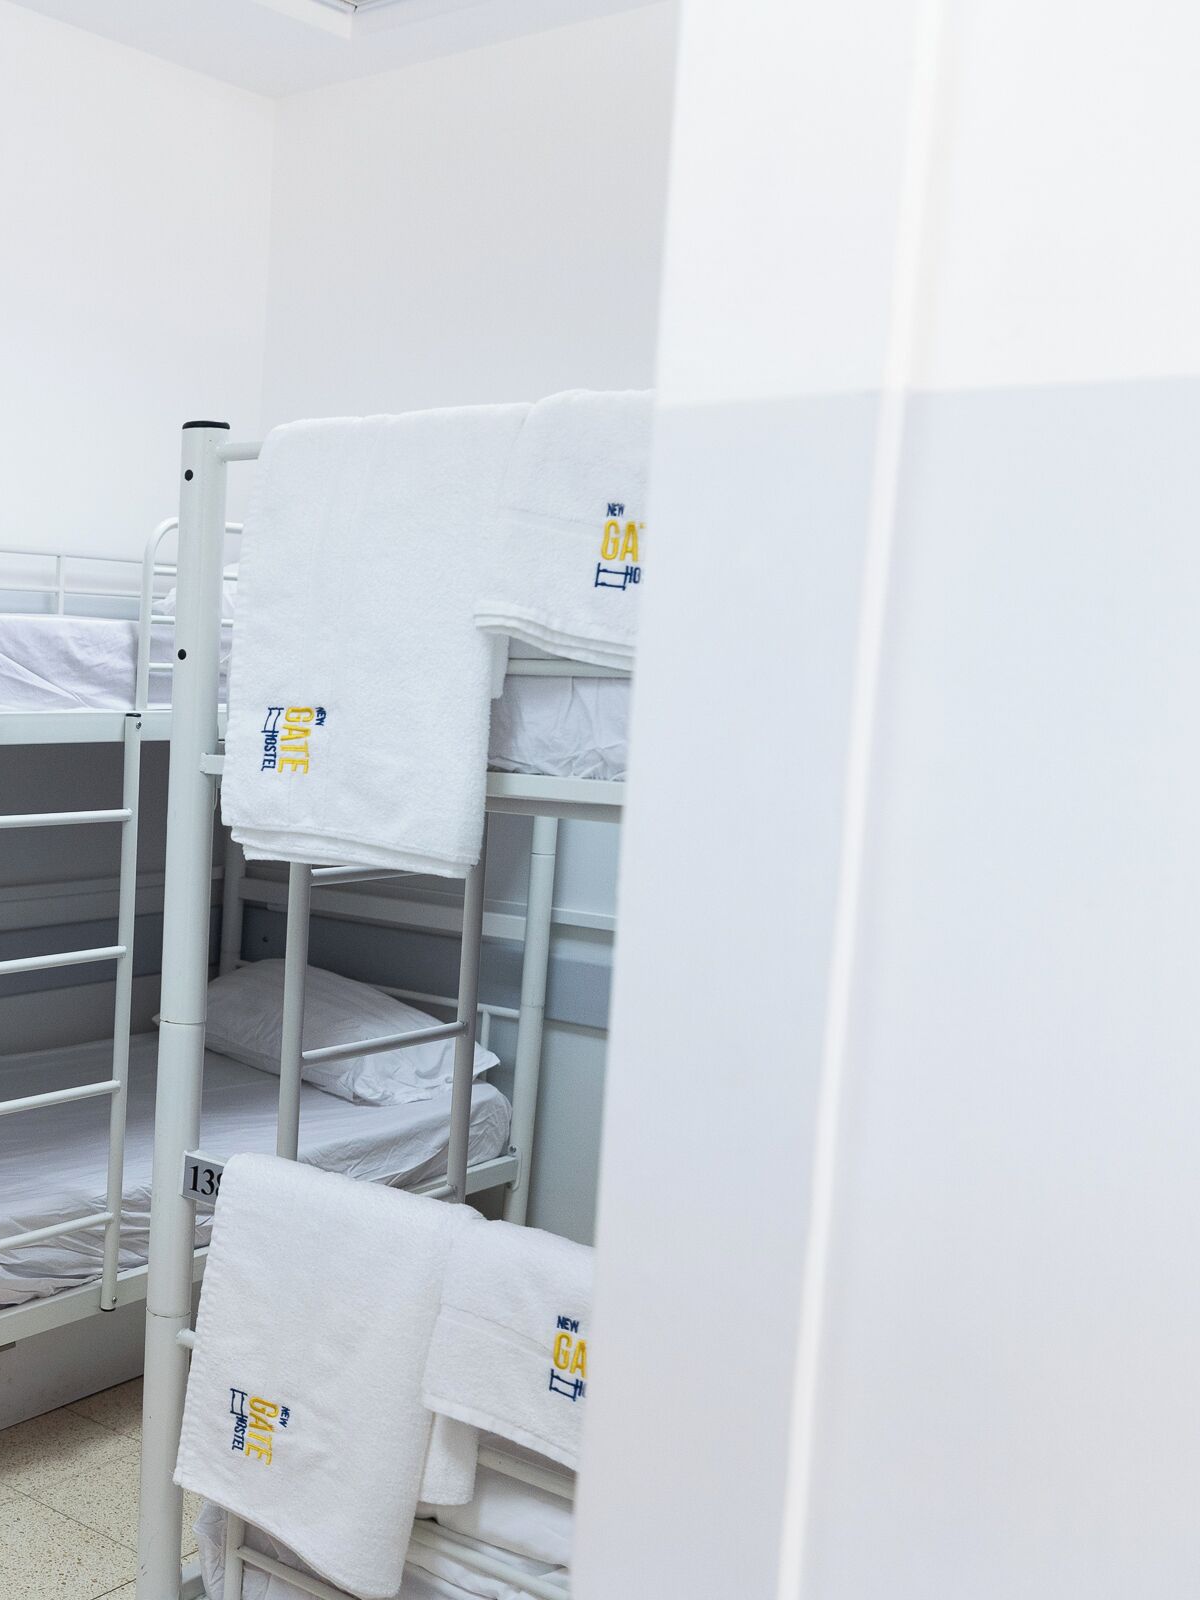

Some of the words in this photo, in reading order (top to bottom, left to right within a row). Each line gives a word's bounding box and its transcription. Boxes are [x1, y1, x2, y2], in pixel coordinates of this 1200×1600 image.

[606, 502, 625, 517] NEW
[601, 519, 646, 563] GA
[315, 706, 327, 727] NEW
[261, 730, 279, 771] HOSTEL
[278, 706, 315, 774] GATE
[556, 1315, 579, 1333] NEW
[230, 1413, 248, 1451] HOSTEL
[245, 1396, 280, 1466] GATE
[279, 1405, 291, 1428] NEW
